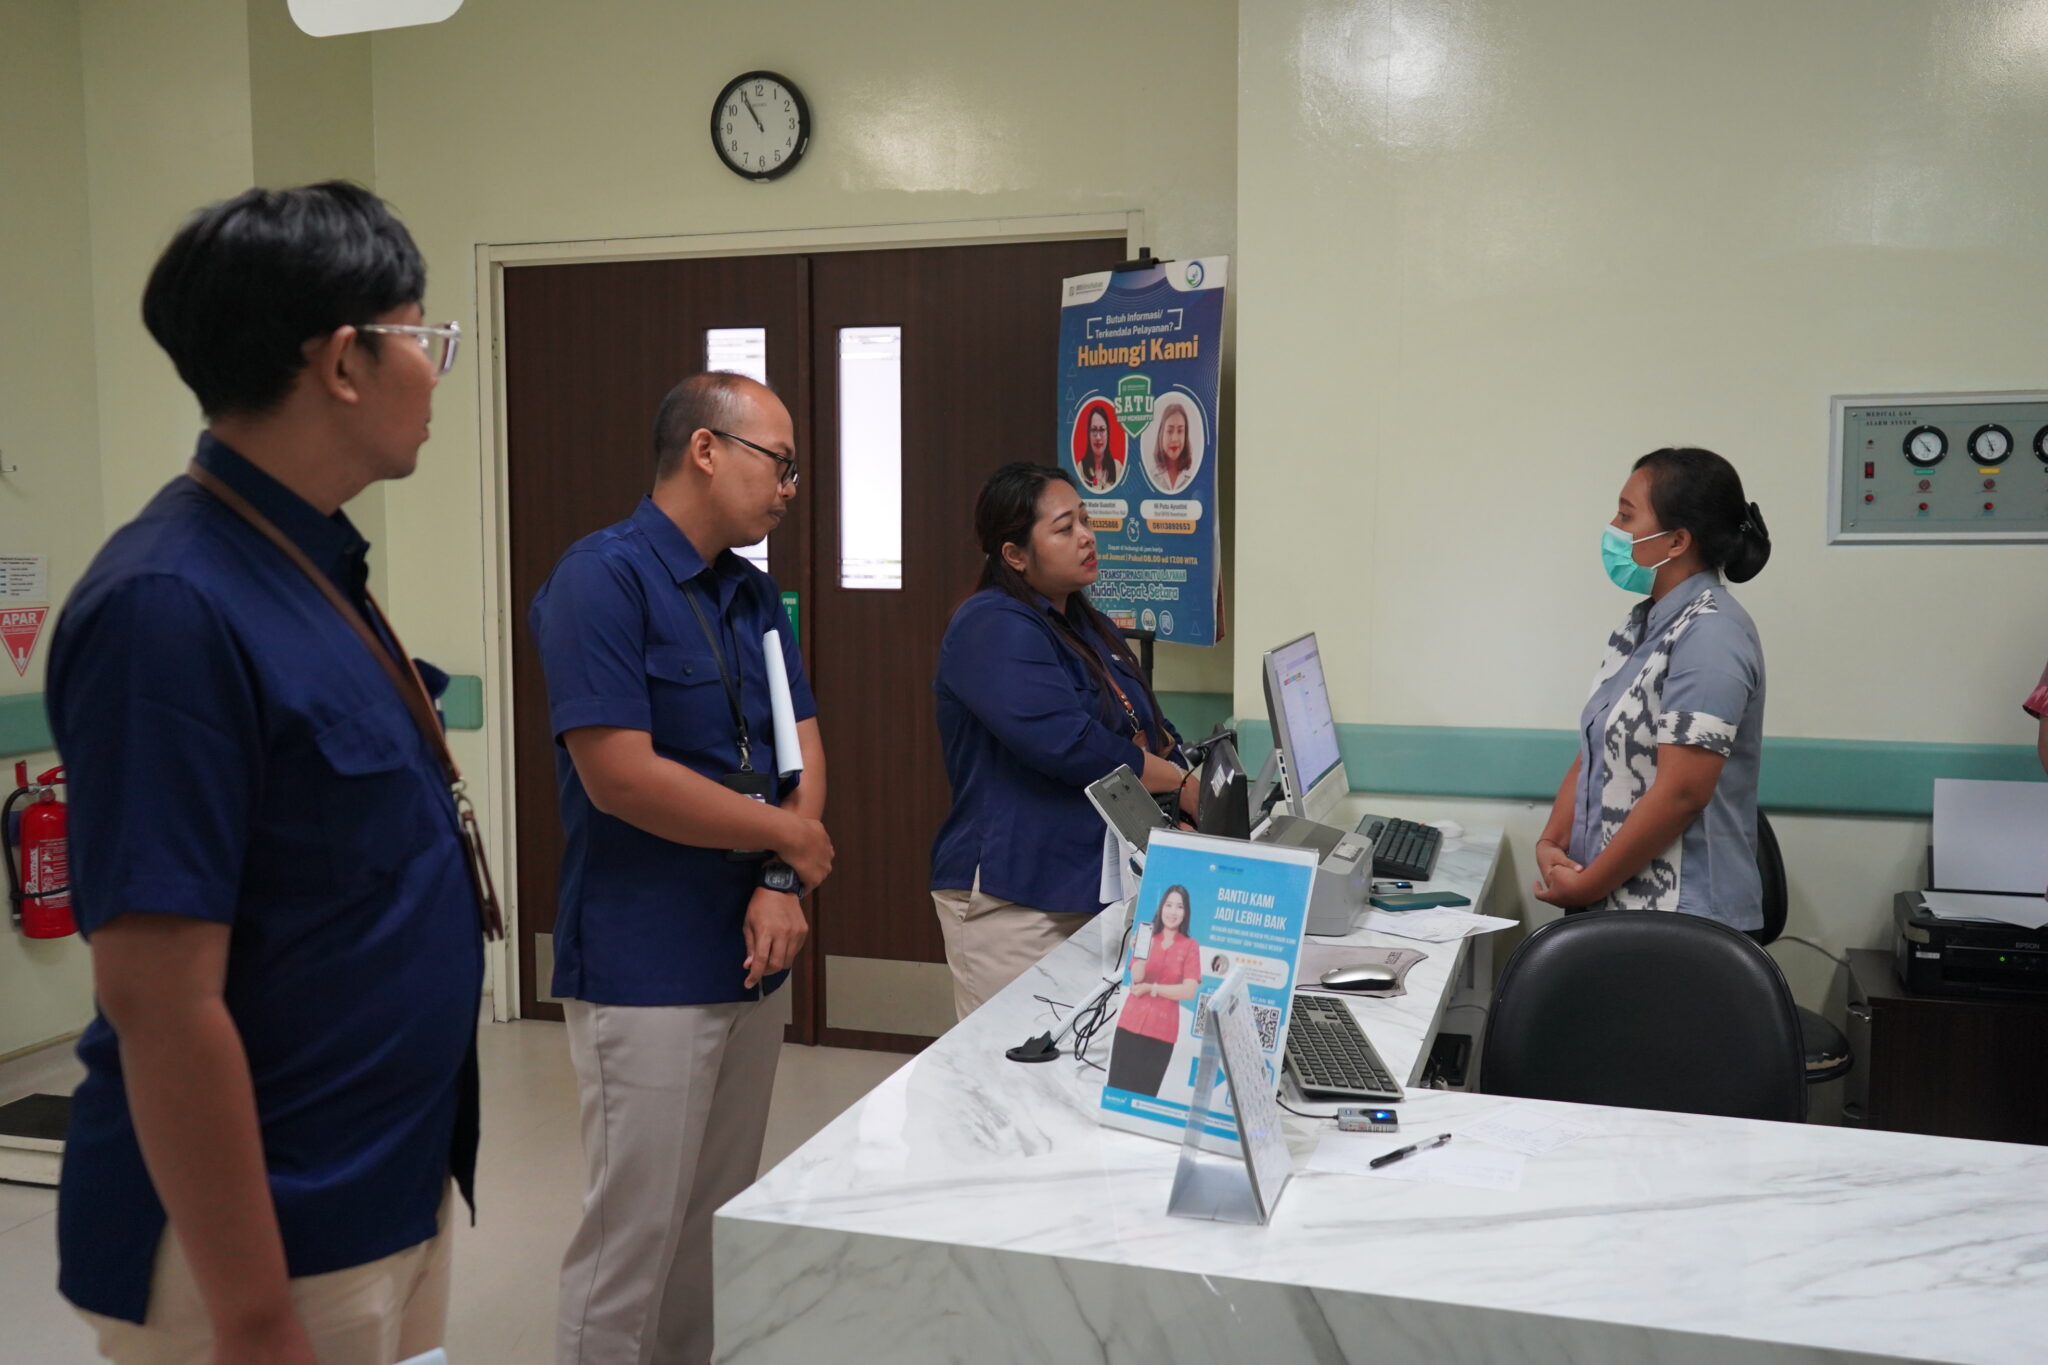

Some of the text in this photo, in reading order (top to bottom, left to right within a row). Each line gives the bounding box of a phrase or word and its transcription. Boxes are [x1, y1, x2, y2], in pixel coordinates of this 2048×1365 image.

[755, 84, 763, 97] 12
[773, 88, 777, 100] 1
[728, 104, 738, 117] 10
[784, 100, 790, 112] 2
[726, 122, 733, 135] 9
[789, 118, 795, 130] 3
[731, 140, 738, 152] 8
[785, 137, 791, 148] 4
[743, 152, 749, 164] 7
[759, 155, 765, 167] 6
[774, 150, 780, 161] 5
[1106, 314, 1126, 325] Butuh
[1095, 322, 1174, 339] Terkendala Pelayanan?
[1077, 334, 1199, 367] Hubungi Kami
[1114, 395, 1155, 414] SATU
[1149, 583, 1179, 599] Setara
[2, 613, 37, 626] APAR
[1217, 887, 1275, 909] BANTU KAMI
[1214, 906, 1288, 931] JADI LEBIH BAIK
